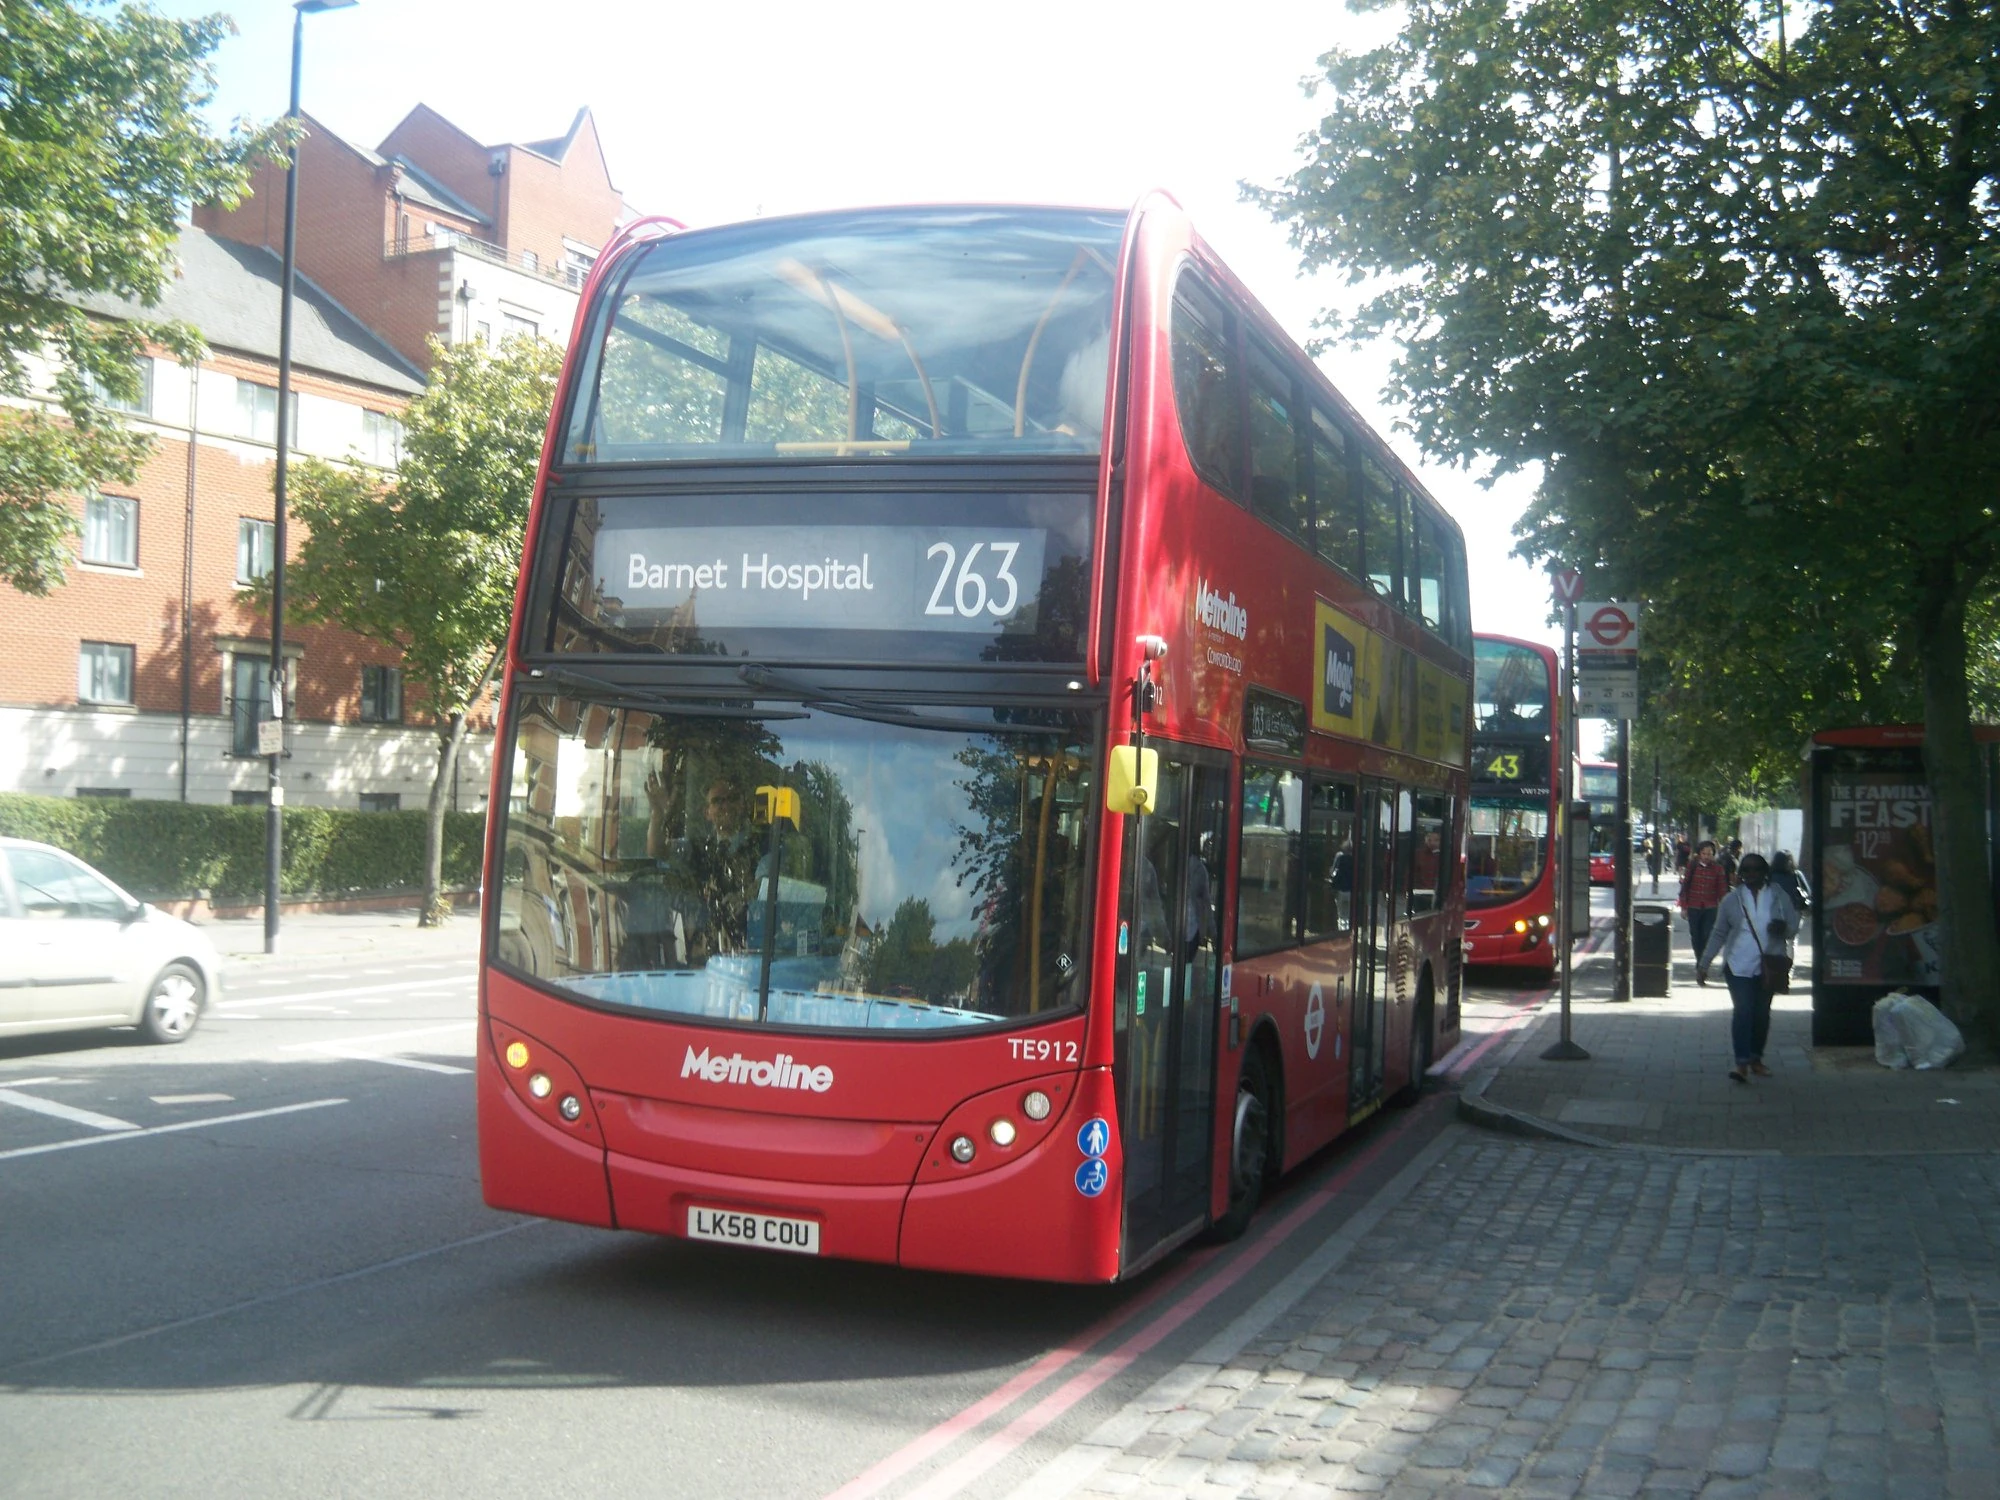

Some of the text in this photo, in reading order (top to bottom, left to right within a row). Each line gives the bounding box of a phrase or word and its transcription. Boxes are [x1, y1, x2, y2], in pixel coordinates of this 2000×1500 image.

[627, 552, 874, 600] Barnet Hospital
[924, 541, 1021, 618] 263
[1558, 574, 1578, 598] V
[1195, 575, 1247, 641] Metroline
[1487, 755, 1519, 779] 43
[1830, 784, 1931, 800] THE FAMILY
[1829, 800, 1933, 829] FEAST
[1008, 1037, 1078, 1062] TE912
[680, 1044, 834, 1093] Metroline
[696, 1210, 810, 1247] LK58 COU
